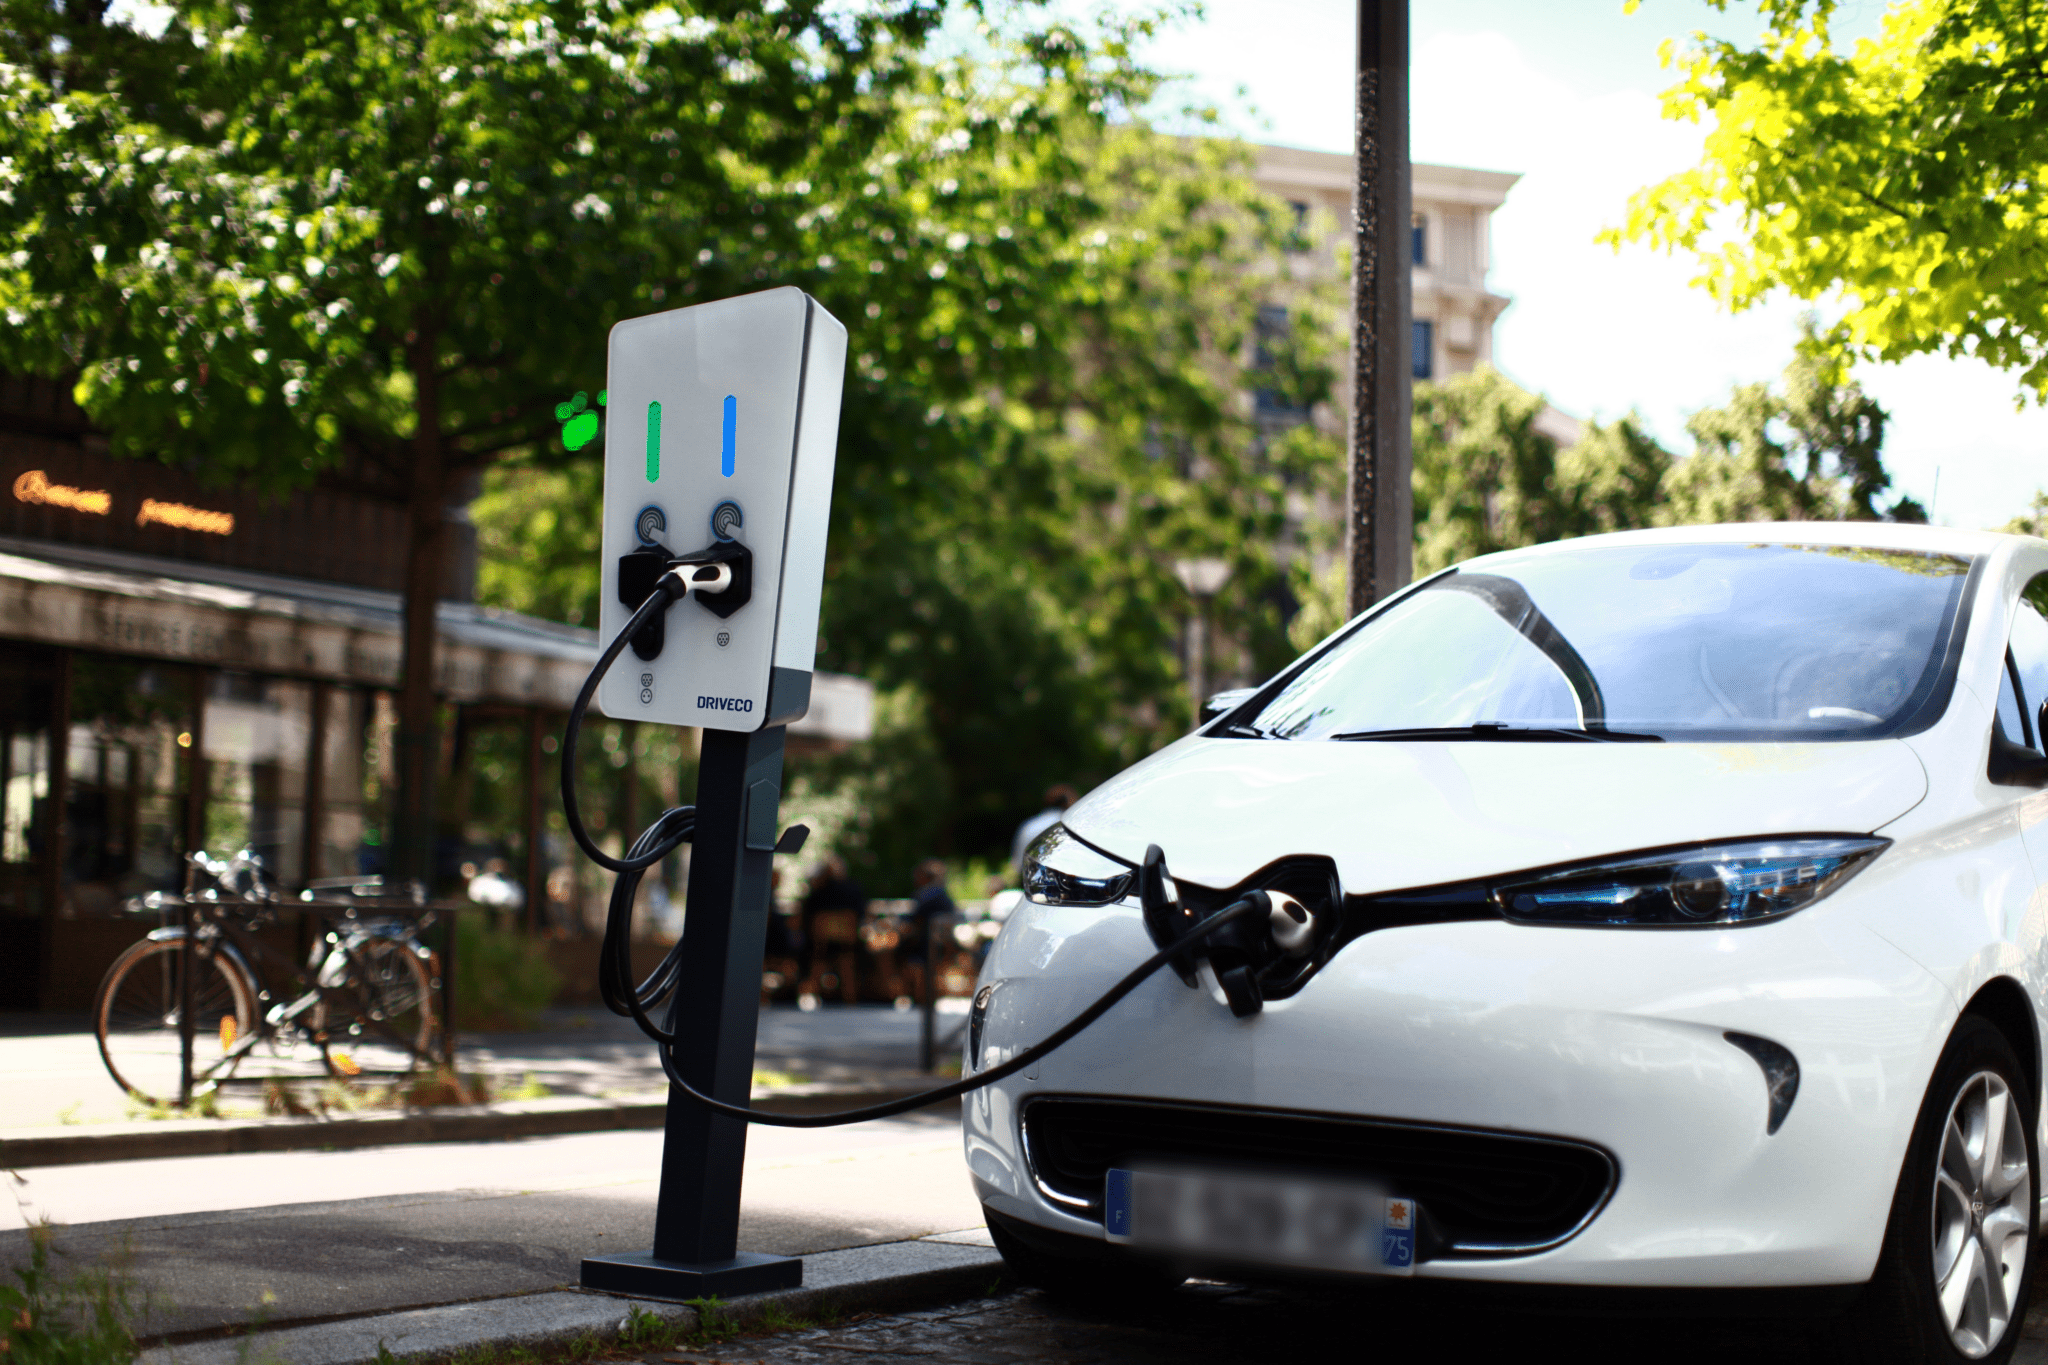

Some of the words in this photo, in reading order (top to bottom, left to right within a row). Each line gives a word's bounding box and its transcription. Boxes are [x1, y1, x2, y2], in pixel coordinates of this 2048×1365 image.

[697, 696, 753, 712] DRIVECO
[1116, 1210, 1123, 1224] F
[1385, 1235, 1410, 1262] 75
